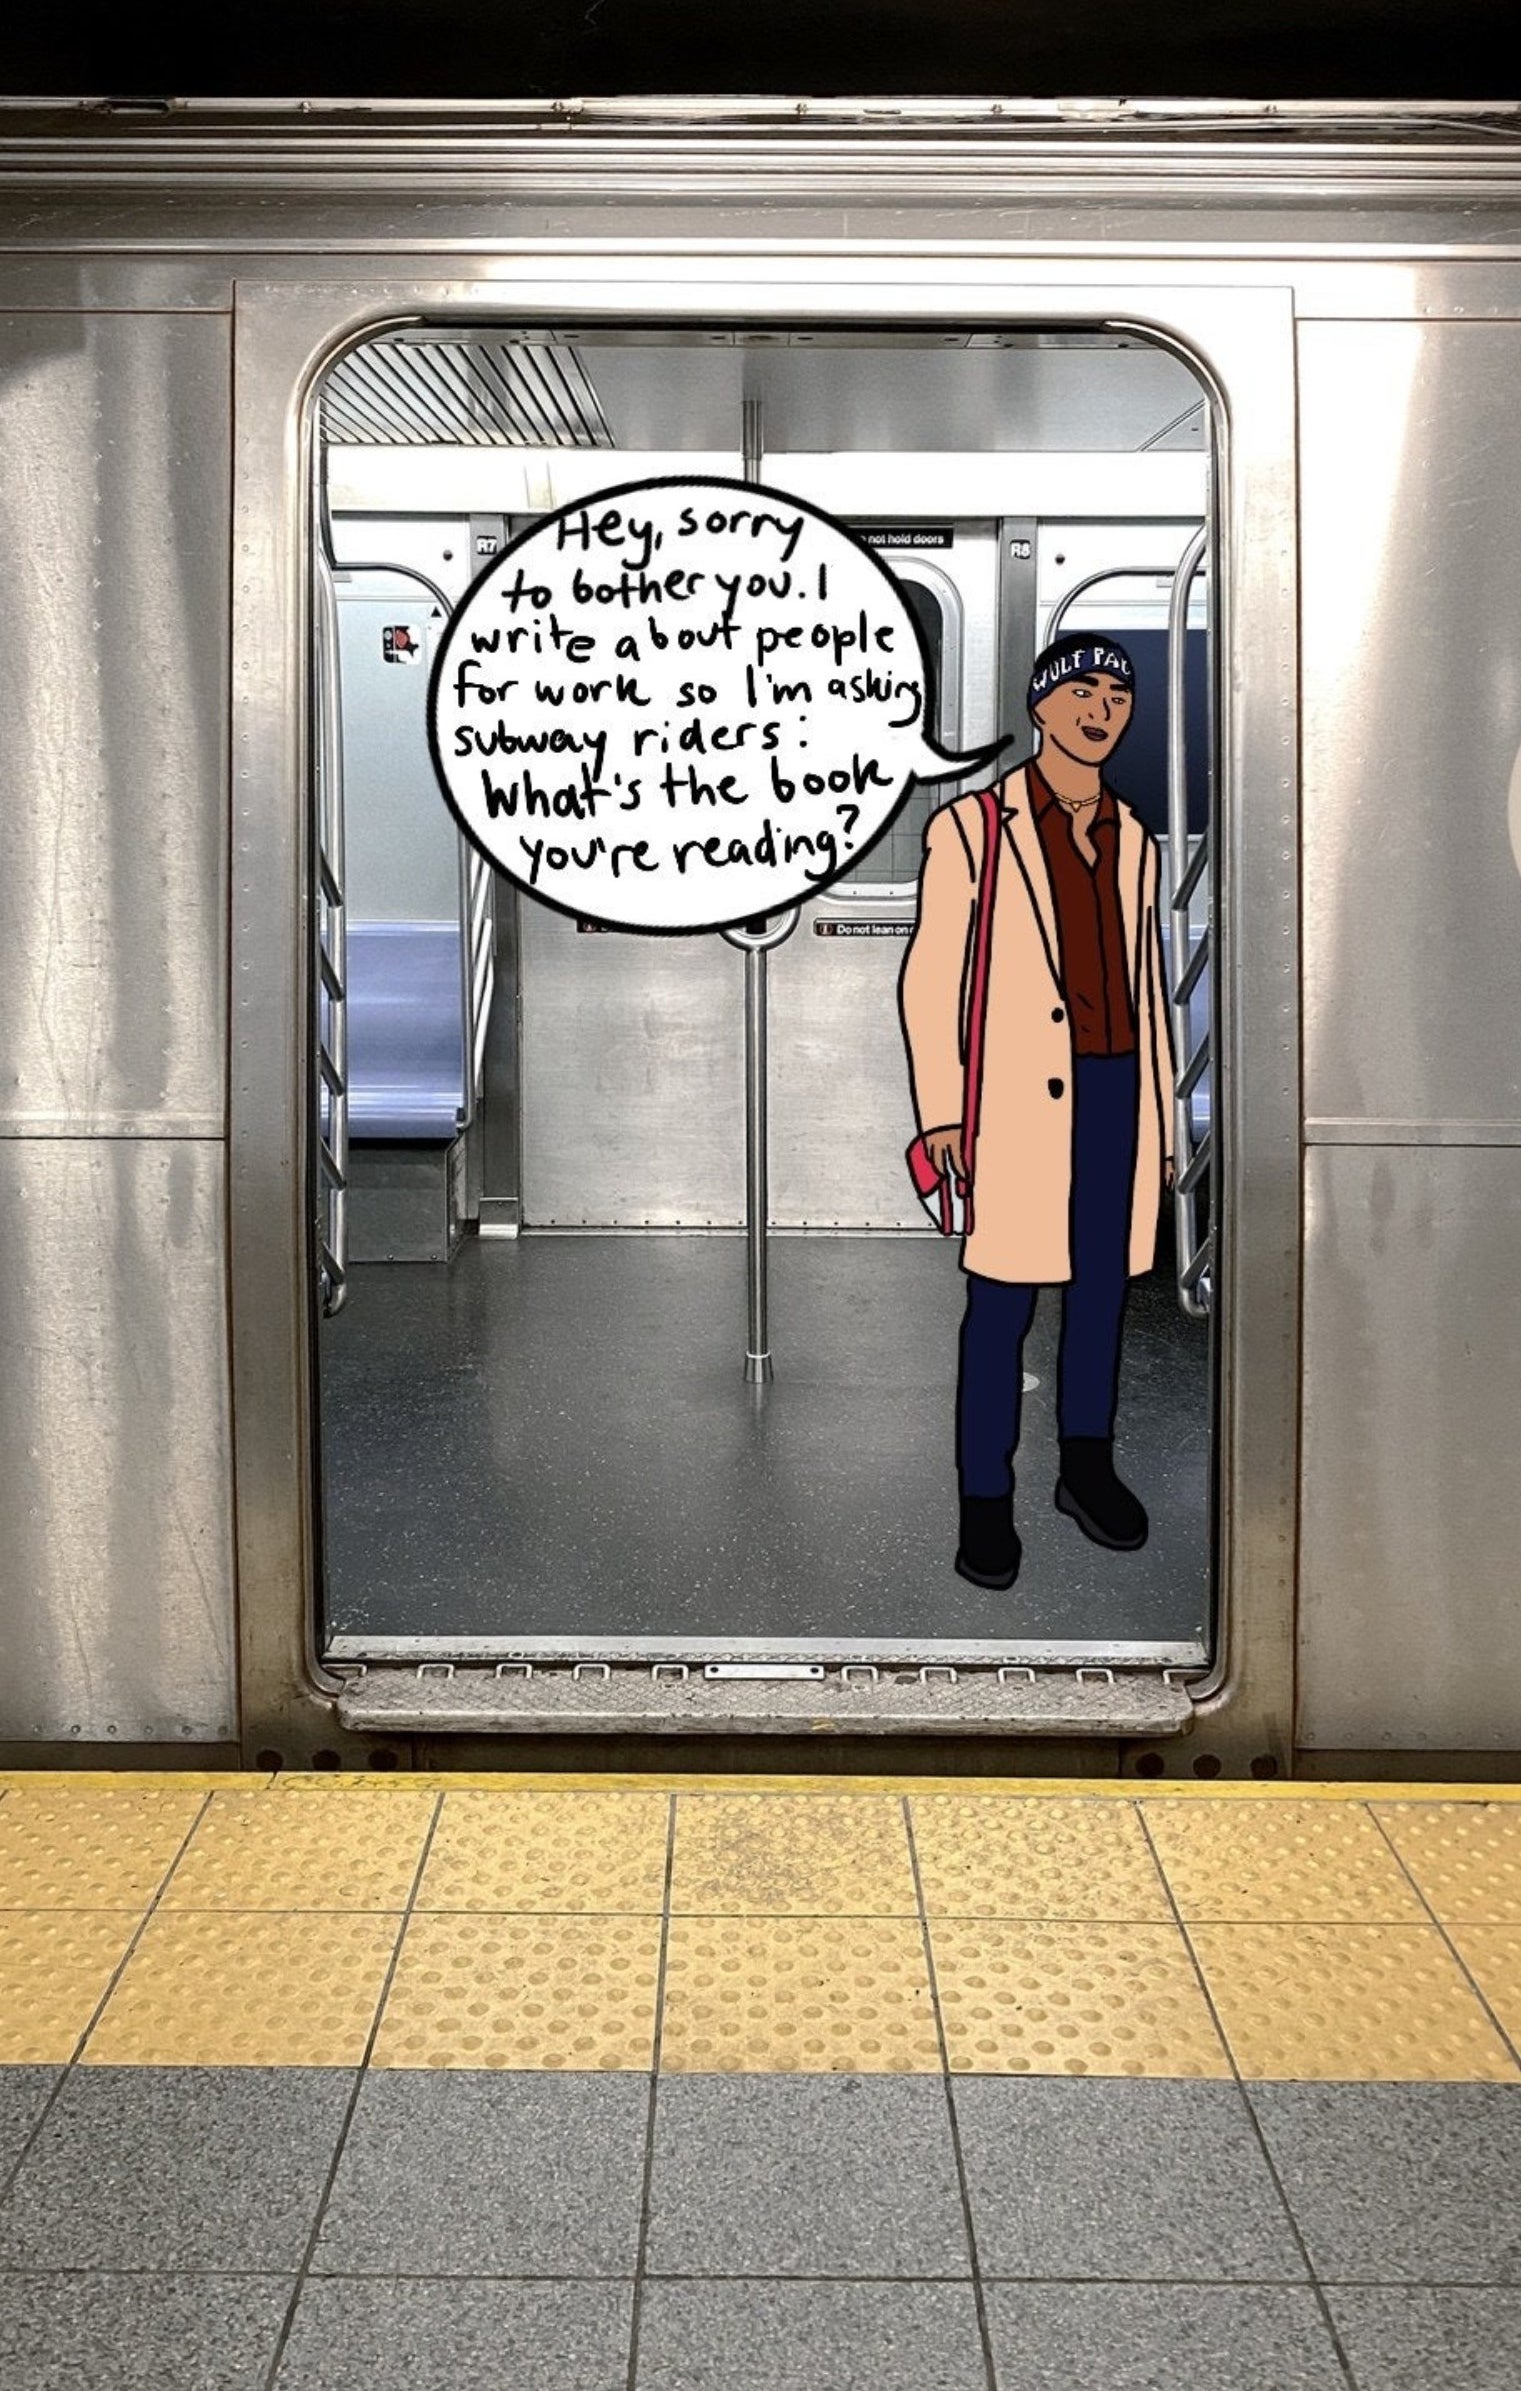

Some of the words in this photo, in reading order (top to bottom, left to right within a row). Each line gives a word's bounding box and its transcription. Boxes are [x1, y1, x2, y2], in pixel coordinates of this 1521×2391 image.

[477, 538, 498, 553] R7
[867, 534, 886, 545] not
[887, 534, 912, 545] hold
[913, 534, 944, 545] doors
[1010, 541, 1031, 558] R8
[836, 924, 852, 935] Do
[853, 924, 870, 935] not
[871, 924, 894, 935] lean
[895, 925, 909, 935] on
